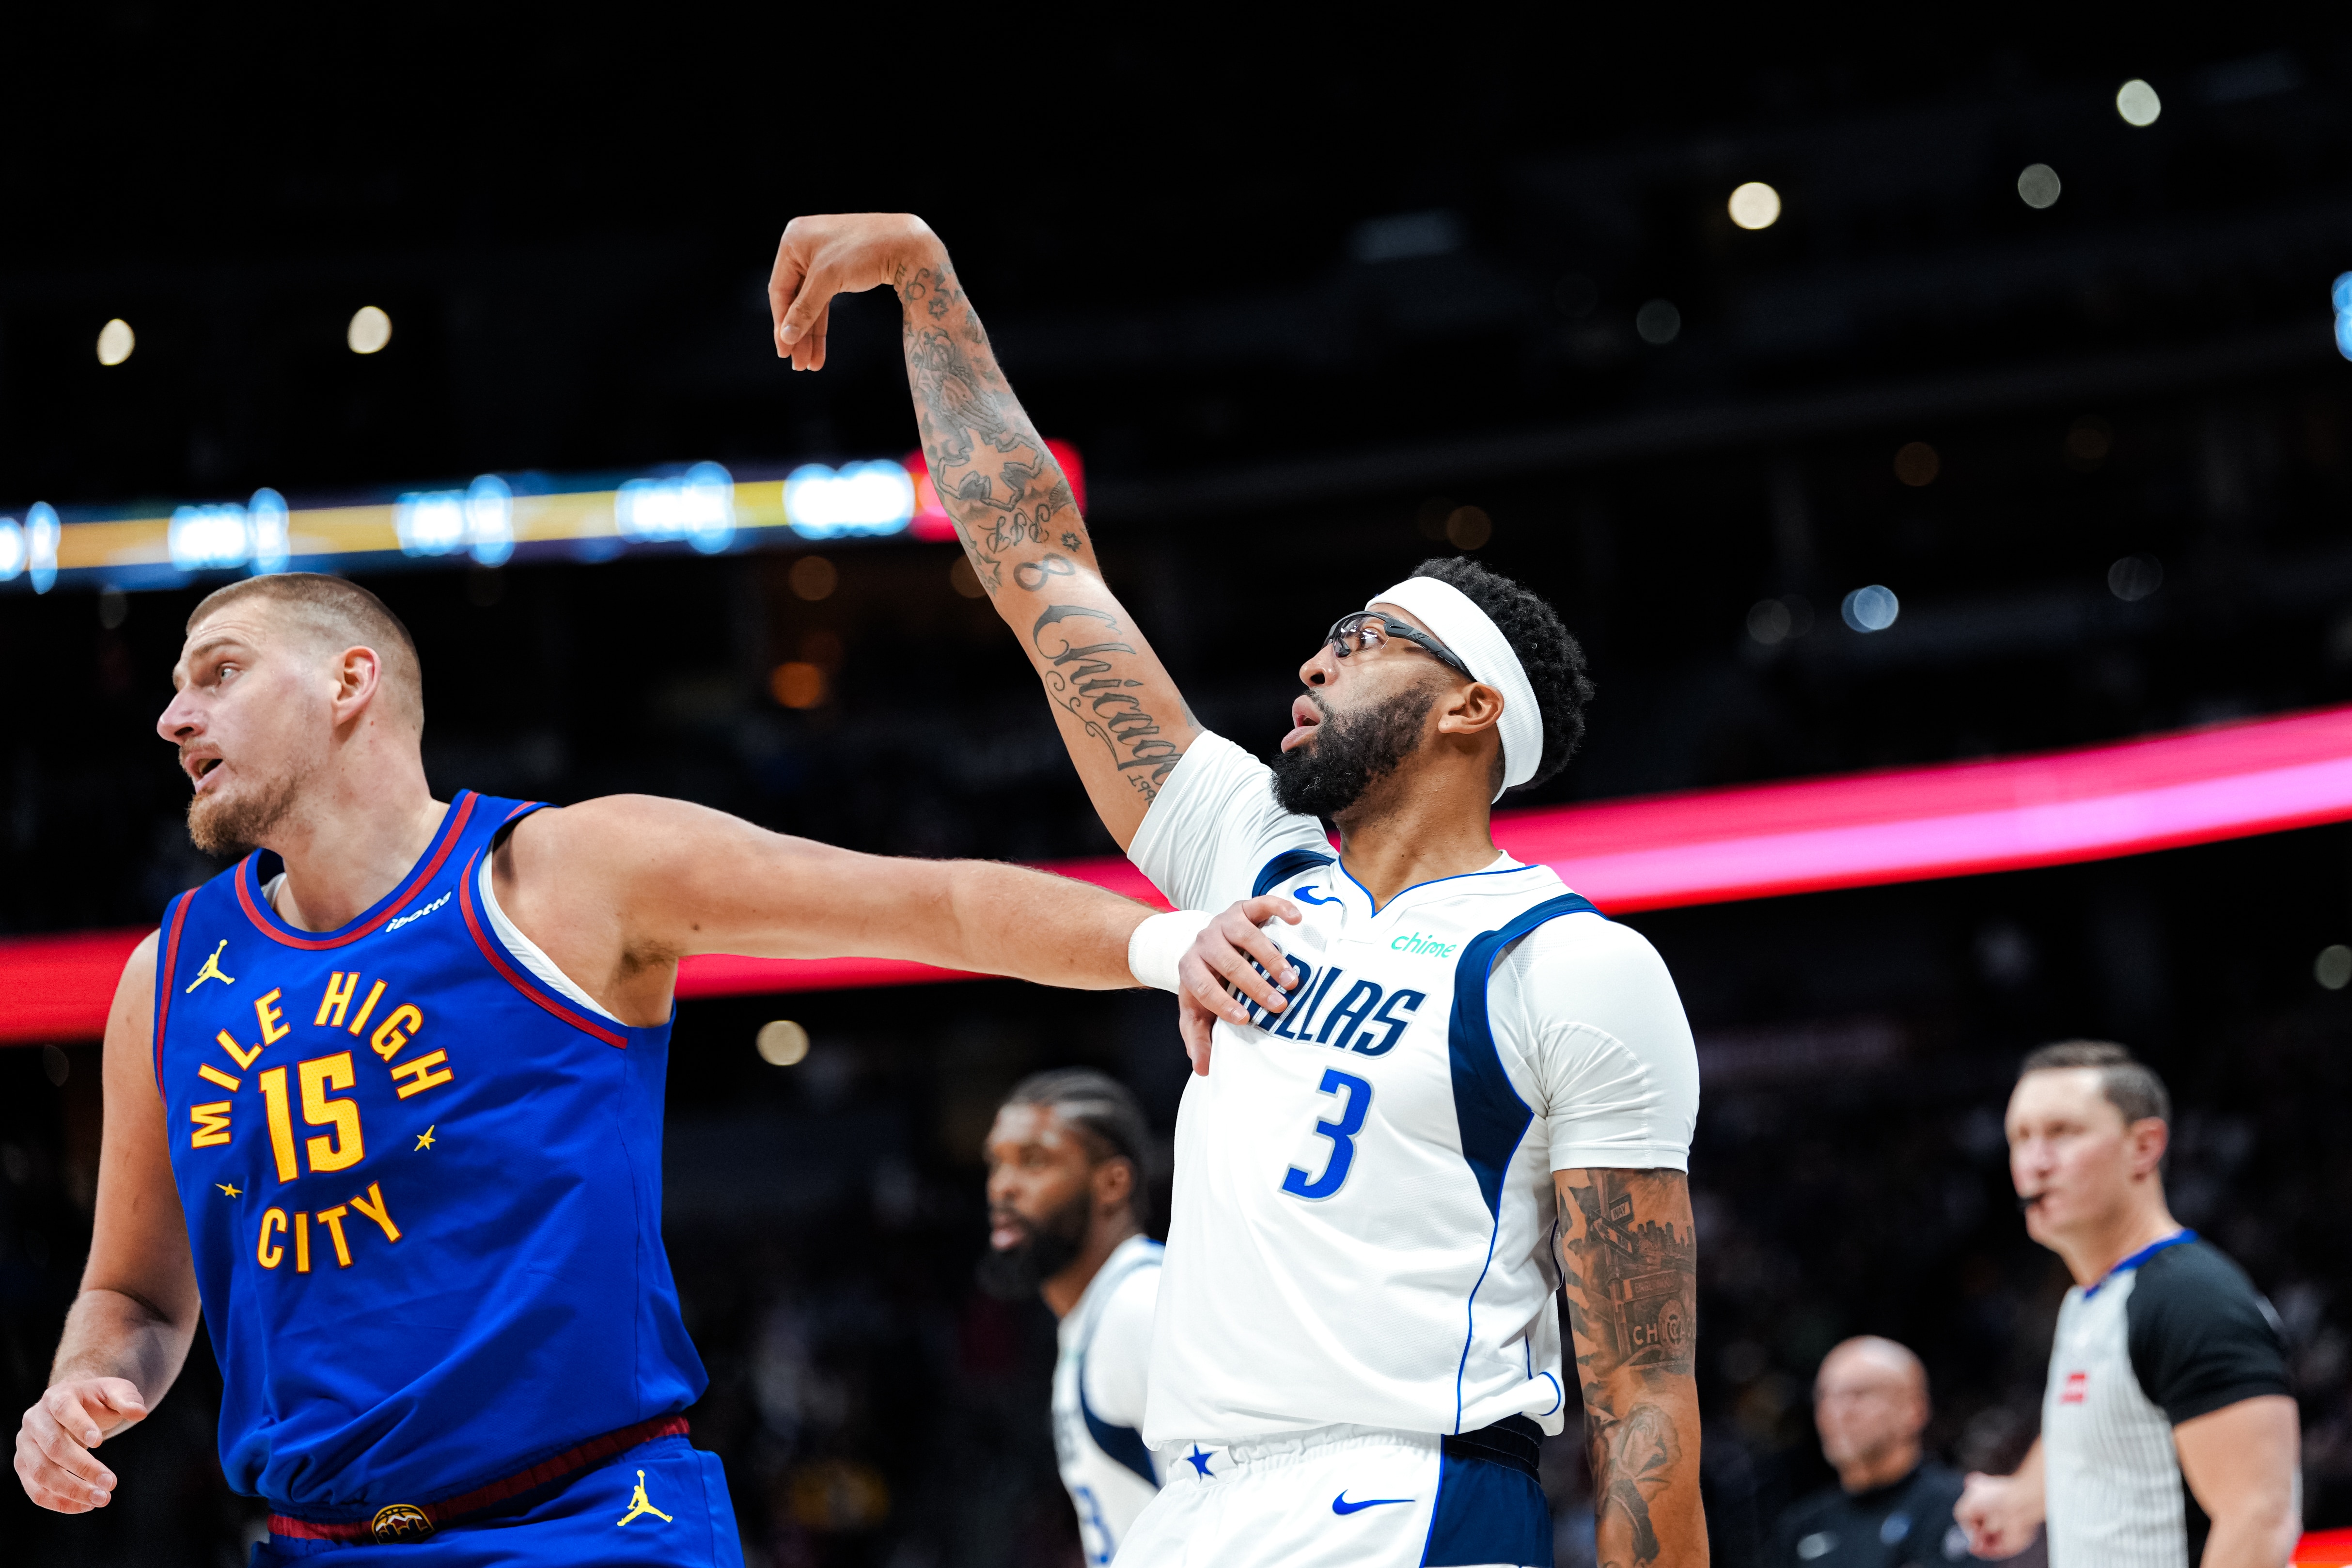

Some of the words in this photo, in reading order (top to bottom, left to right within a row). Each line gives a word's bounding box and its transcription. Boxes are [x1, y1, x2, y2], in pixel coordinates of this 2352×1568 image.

[1127, 775, 1157, 808] 199
[385, 892, 451, 932] ibotta
[1391, 932, 1457, 958] chime
[190, 987, 291, 1149] MILE
[314, 972, 455, 1101] HIGH
[259, 1050, 365, 1185] 15
[1278, 1065, 1375, 1203] 3
[257, 1180, 403, 1274] CITY
